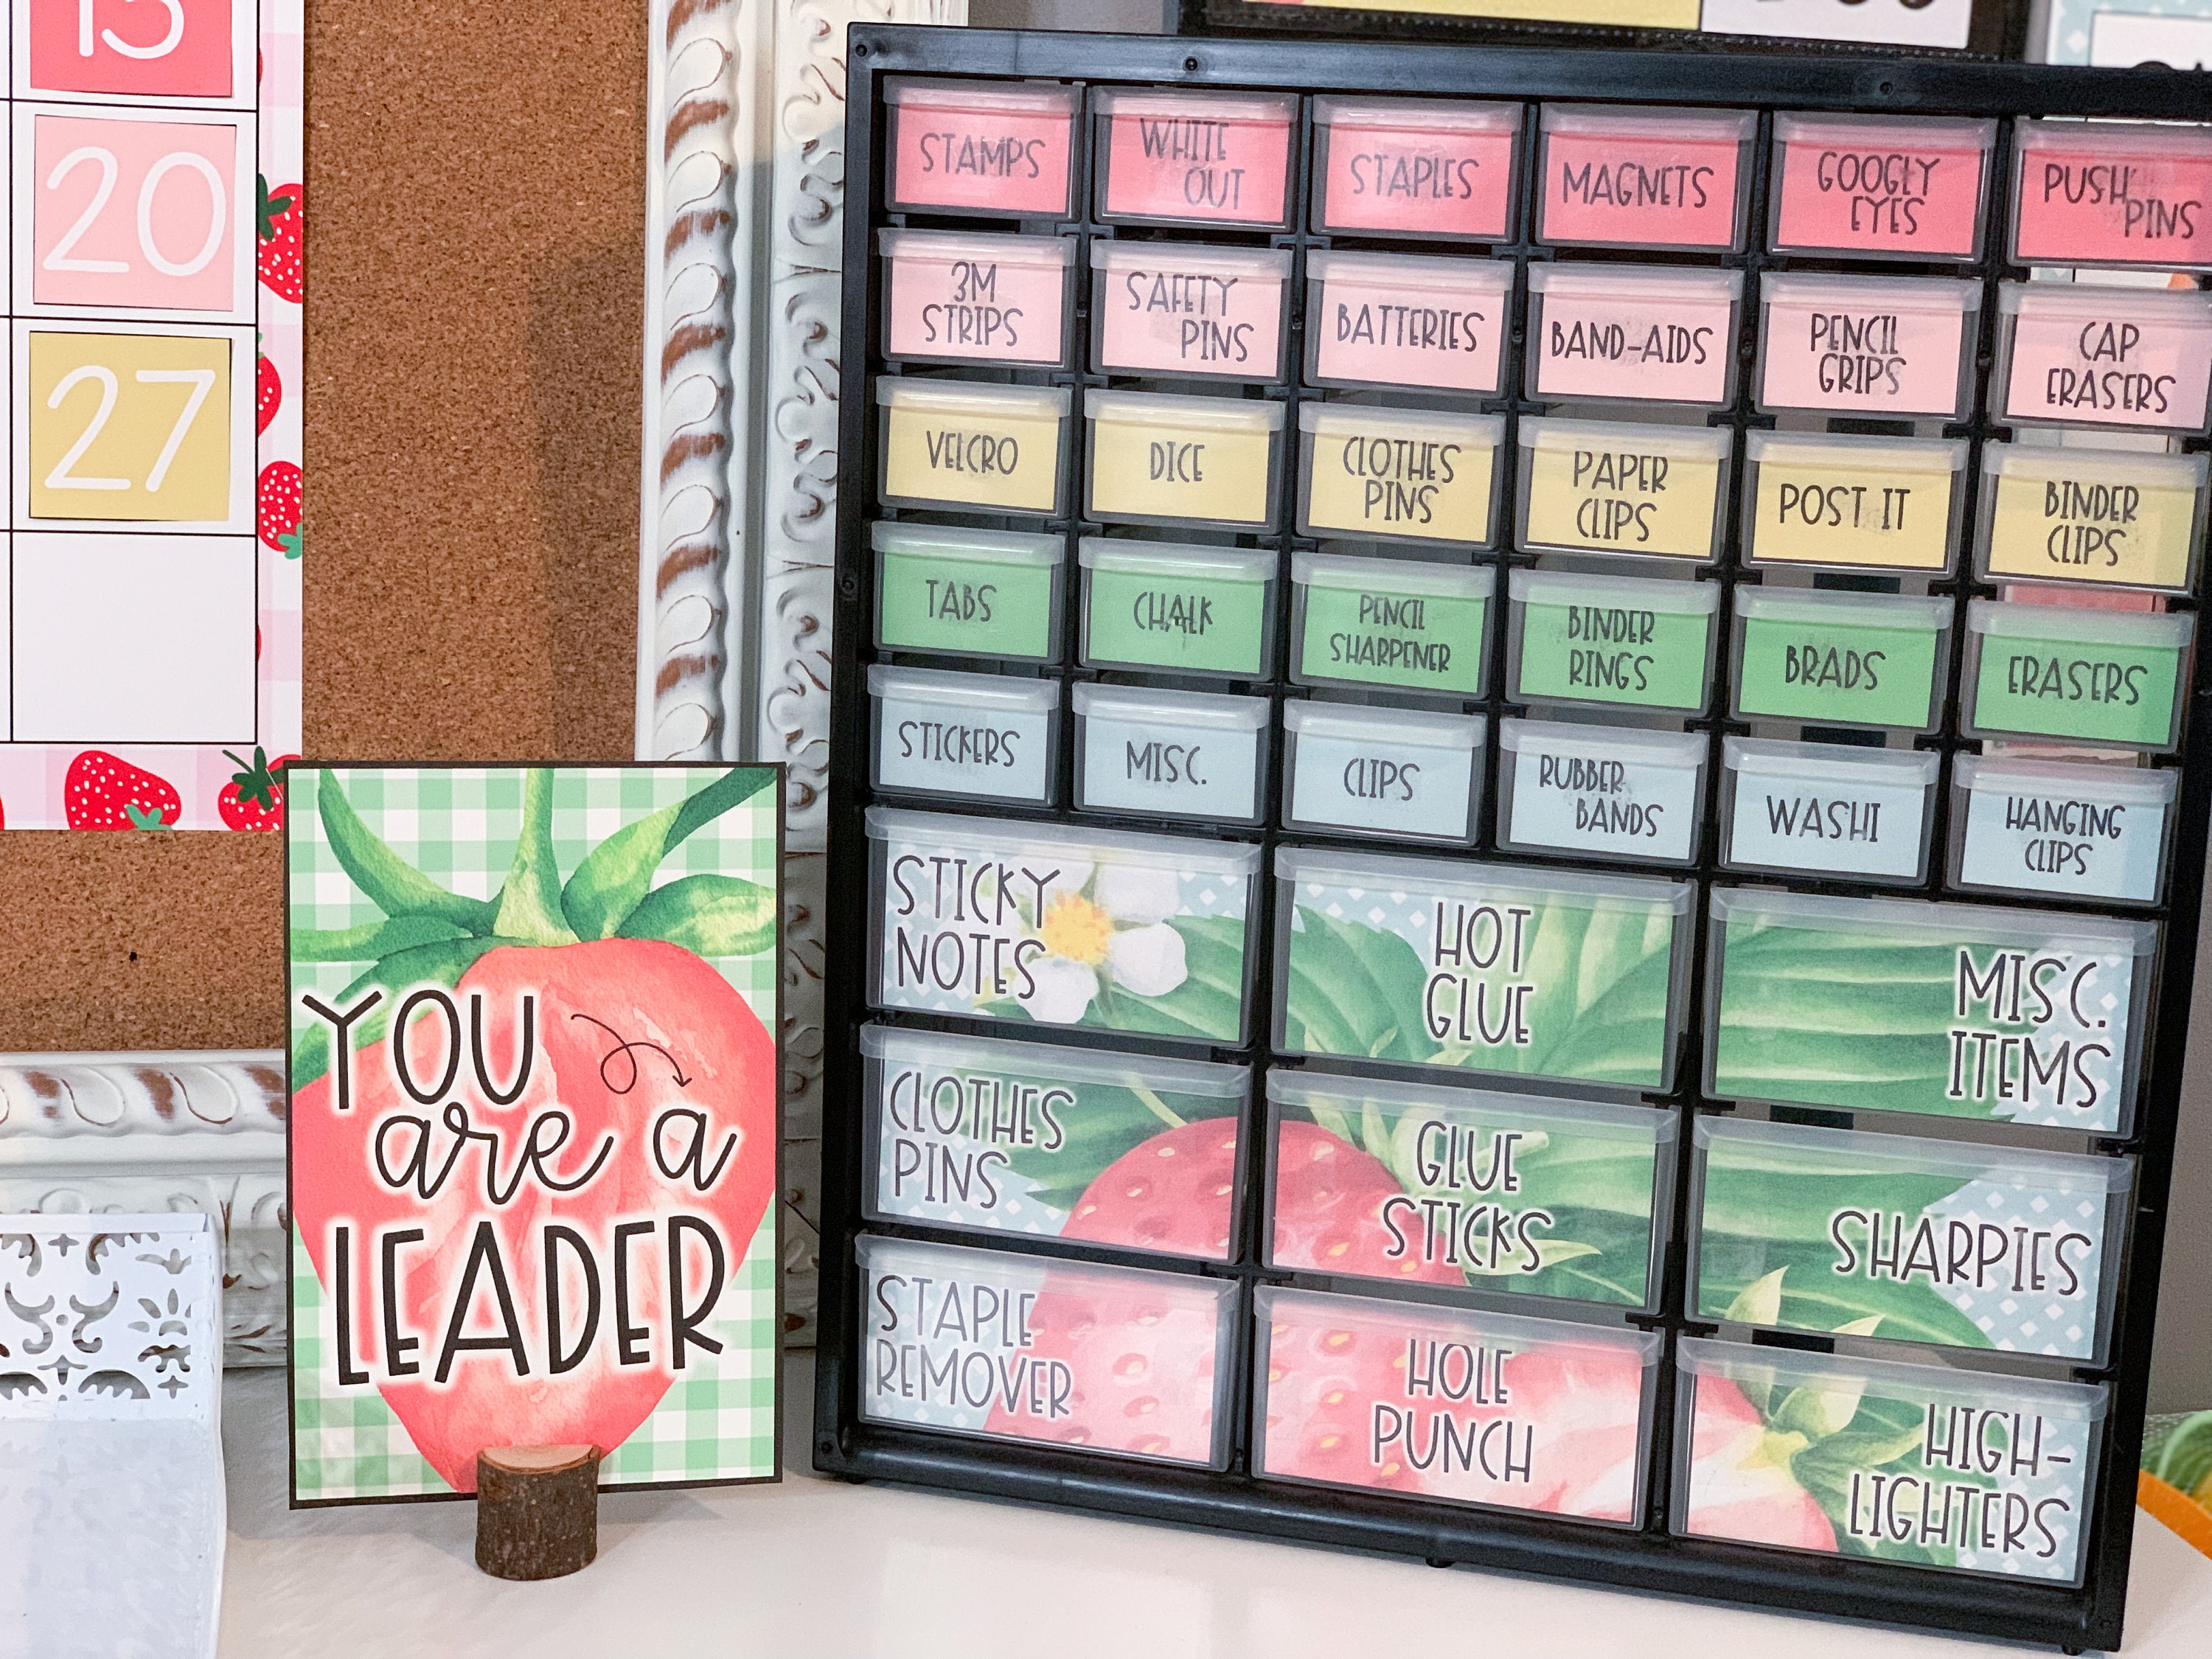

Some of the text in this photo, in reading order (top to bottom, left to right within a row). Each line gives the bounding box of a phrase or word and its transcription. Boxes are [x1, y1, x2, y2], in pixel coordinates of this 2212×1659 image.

[919, 133, 1046, 179] STAMPS
[1139, 119, 1230, 161] WHITE
[1184, 170, 1245, 210] OUT
[1350, 155, 1480, 200] STAPLES
[1562, 163, 1714, 209] MAGNETS
[1818, 151, 1940, 196] GOOGLY
[2044, 164, 2131, 202] PUSH
[43, 146, 226, 276] 20
[1851, 196, 1925, 235] EYES
[2124, 200, 2201, 239] PINS
[951, 262, 997, 303] 3M
[1127, 271, 1238, 316] SAFETY
[922, 304, 1023, 347] STRIPS
[1180, 320, 1254, 362] PINS
[1337, 303, 1485, 352] BATTERIES
[1551, 322, 1714, 365] BAND-AIDS
[1812, 314, 1899, 355] PENCIL
[2079, 321, 2140, 361] CAP
[1819, 353, 1907, 395] GRIPS
[2046, 368, 2177, 413] ERASERS
[45, 365, 215, 493] 27
[926, 431, 1018, 475] VELCRO
[1150, 442, 1205, 483] DICE
[1343, 436, 1462, 484] CLOTHES
[1573, 451, 1669, 493] PAPER
[1364, 480, 1439, 524] PINS
[1576, 499, 1658, 543] CLIPS
[1780, 483, 1911, 531] POST IT
[2044, 481, 2139, 522] BINDER
[2047, 526, 2127, 567] CLIPS
[925, 580, 997, 622] TABS
[1133, 591, 1214, 636] CHALK
[1360, 594, 1425, 630] PENCIL
[1568, 605, 1655, 646] BINDER
[1329, 633, 1451, 673] SHARPENER
[1570, 650, 1655, 692] RINGS
[1785, 645, 1886, 690] BRADS
[2008, 656, 2149, 705] ERASERS
[897, 721, 1020, 767] STICKERS
[1126, 740, 1208, 785] MISC.
[1343, 758, 1420, 801] CLIPS
[1540, 755, 1624, 793] RUBBER
[1576, 798, 1664, 838] BANDS
[1767, 796, 1882, 843] WASHI
[2006, 796, 2127, 840] HANGING
[2025, 839, 2094, 875] CLIPS
[893, 855, 1061, 929] STICKY
[1436, 901, 1531, 973] HOT
[896, 926, 1046, 1000] NOTES
[1426, 973, 1534, 1044] GLUE
[1958, 950, 2107, 1028] MISC.
[302, 990, 535, 1110] YOU
[1950, 1031, 2110, 1108] ITEMS
[889, 1071, 1074, 1150] CLOTHES
[375, 1102, 737, 1205] are a
[894, 1138, 1009, 1209] PINS
[1416, 1120, 1523, 1192] GLUE
[1382, 1197, 1552, 1270] STICKS
[1832, 1211, 2093, 1295] SHARPIES
[335, 1215, 727, 1385] LEADER
[877, 1275, 1035, 1347] STAPLE
[875, 1339, 1072, 1419] REMOVER
[1407, 1338, 1512, 1404] HOLE
[1373, 1404, 1533, 1484] PUNCH
[1926, 1403, 2071, 1476] HIGH-
[1850, 1473, 2070, 1558] LIGHTERS
